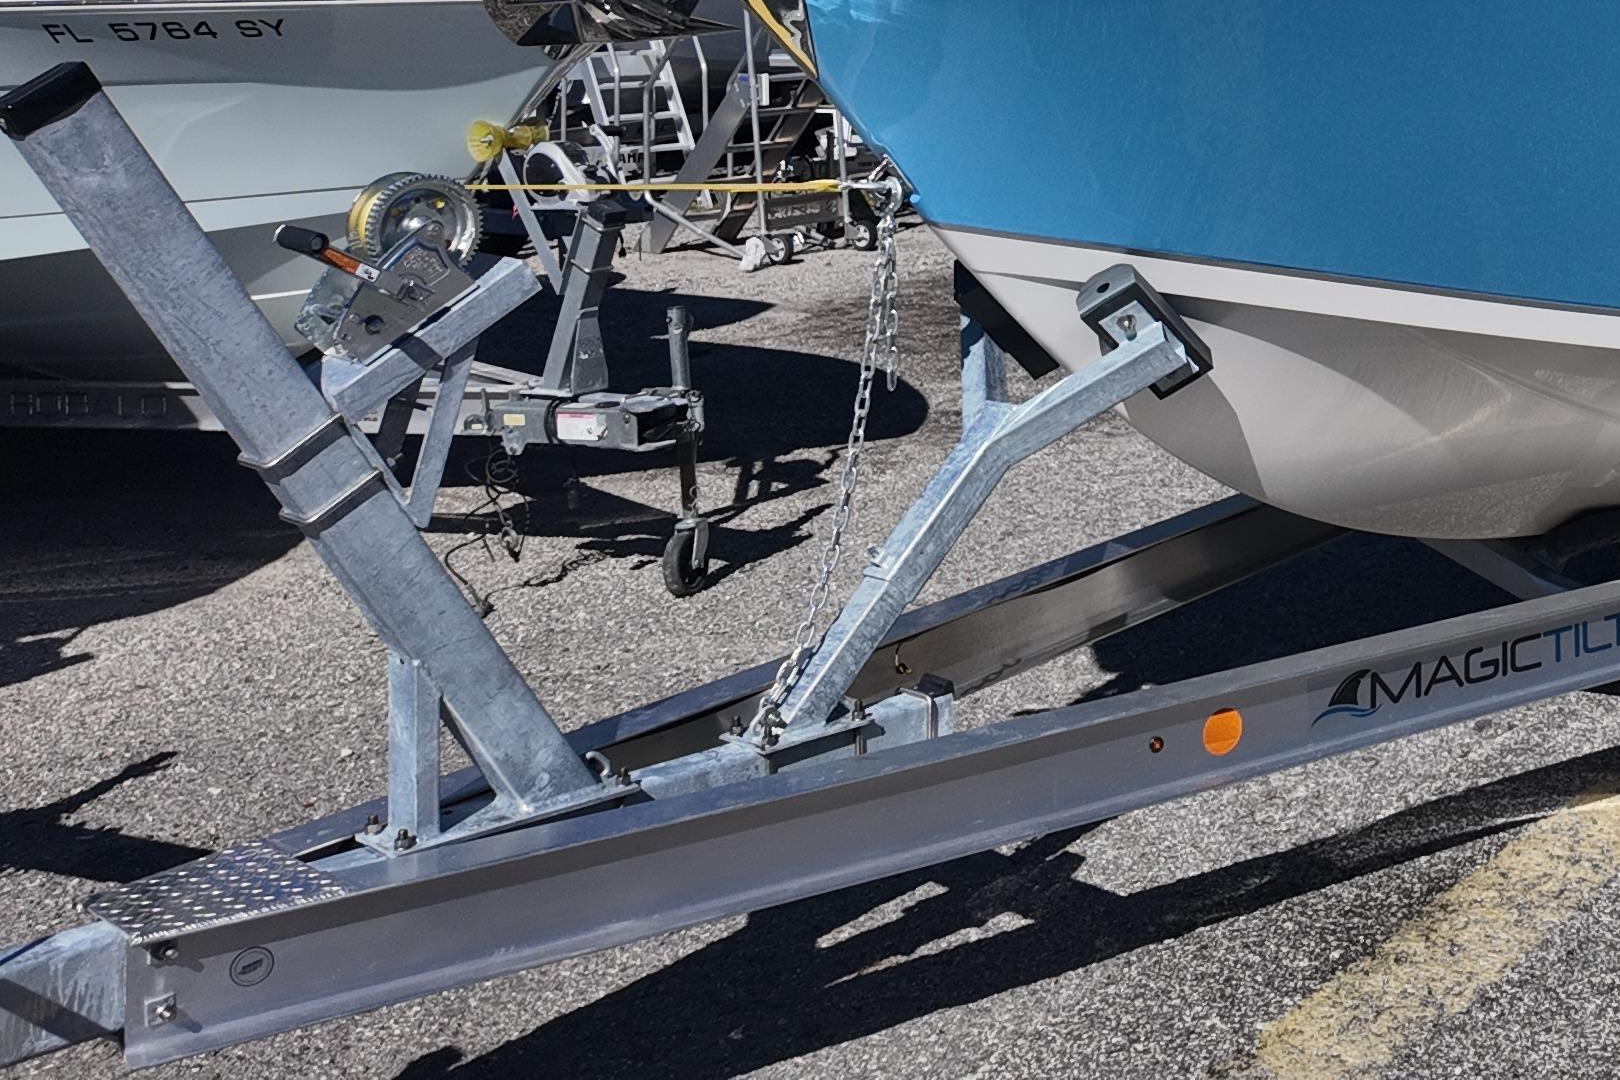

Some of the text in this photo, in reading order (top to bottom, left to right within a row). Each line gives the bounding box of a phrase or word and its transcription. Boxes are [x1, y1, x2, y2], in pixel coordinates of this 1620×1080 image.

[41, 18, 285, 44] FL 5764 SY
